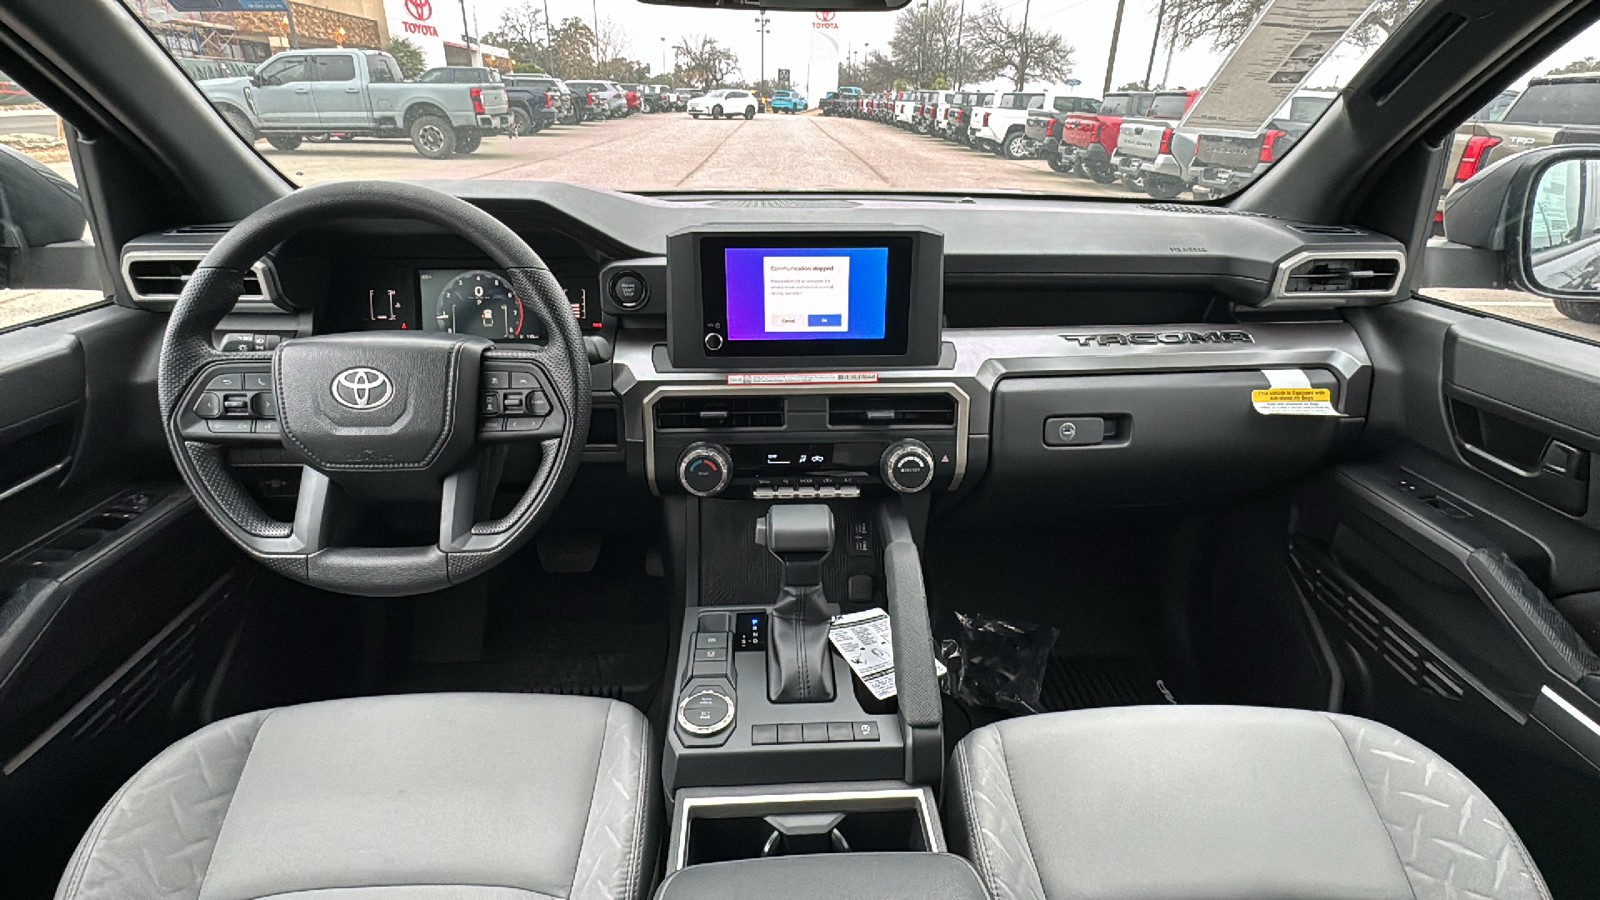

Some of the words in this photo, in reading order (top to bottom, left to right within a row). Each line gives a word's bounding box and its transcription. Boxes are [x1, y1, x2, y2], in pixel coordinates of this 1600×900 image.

[402, 21, 438, 37] TOYOTA
[1124, 140, 1152, 148] TACOMA
[474, 286, 483, 297] 0
[1058, 331, 1255, 348] TACOMA
